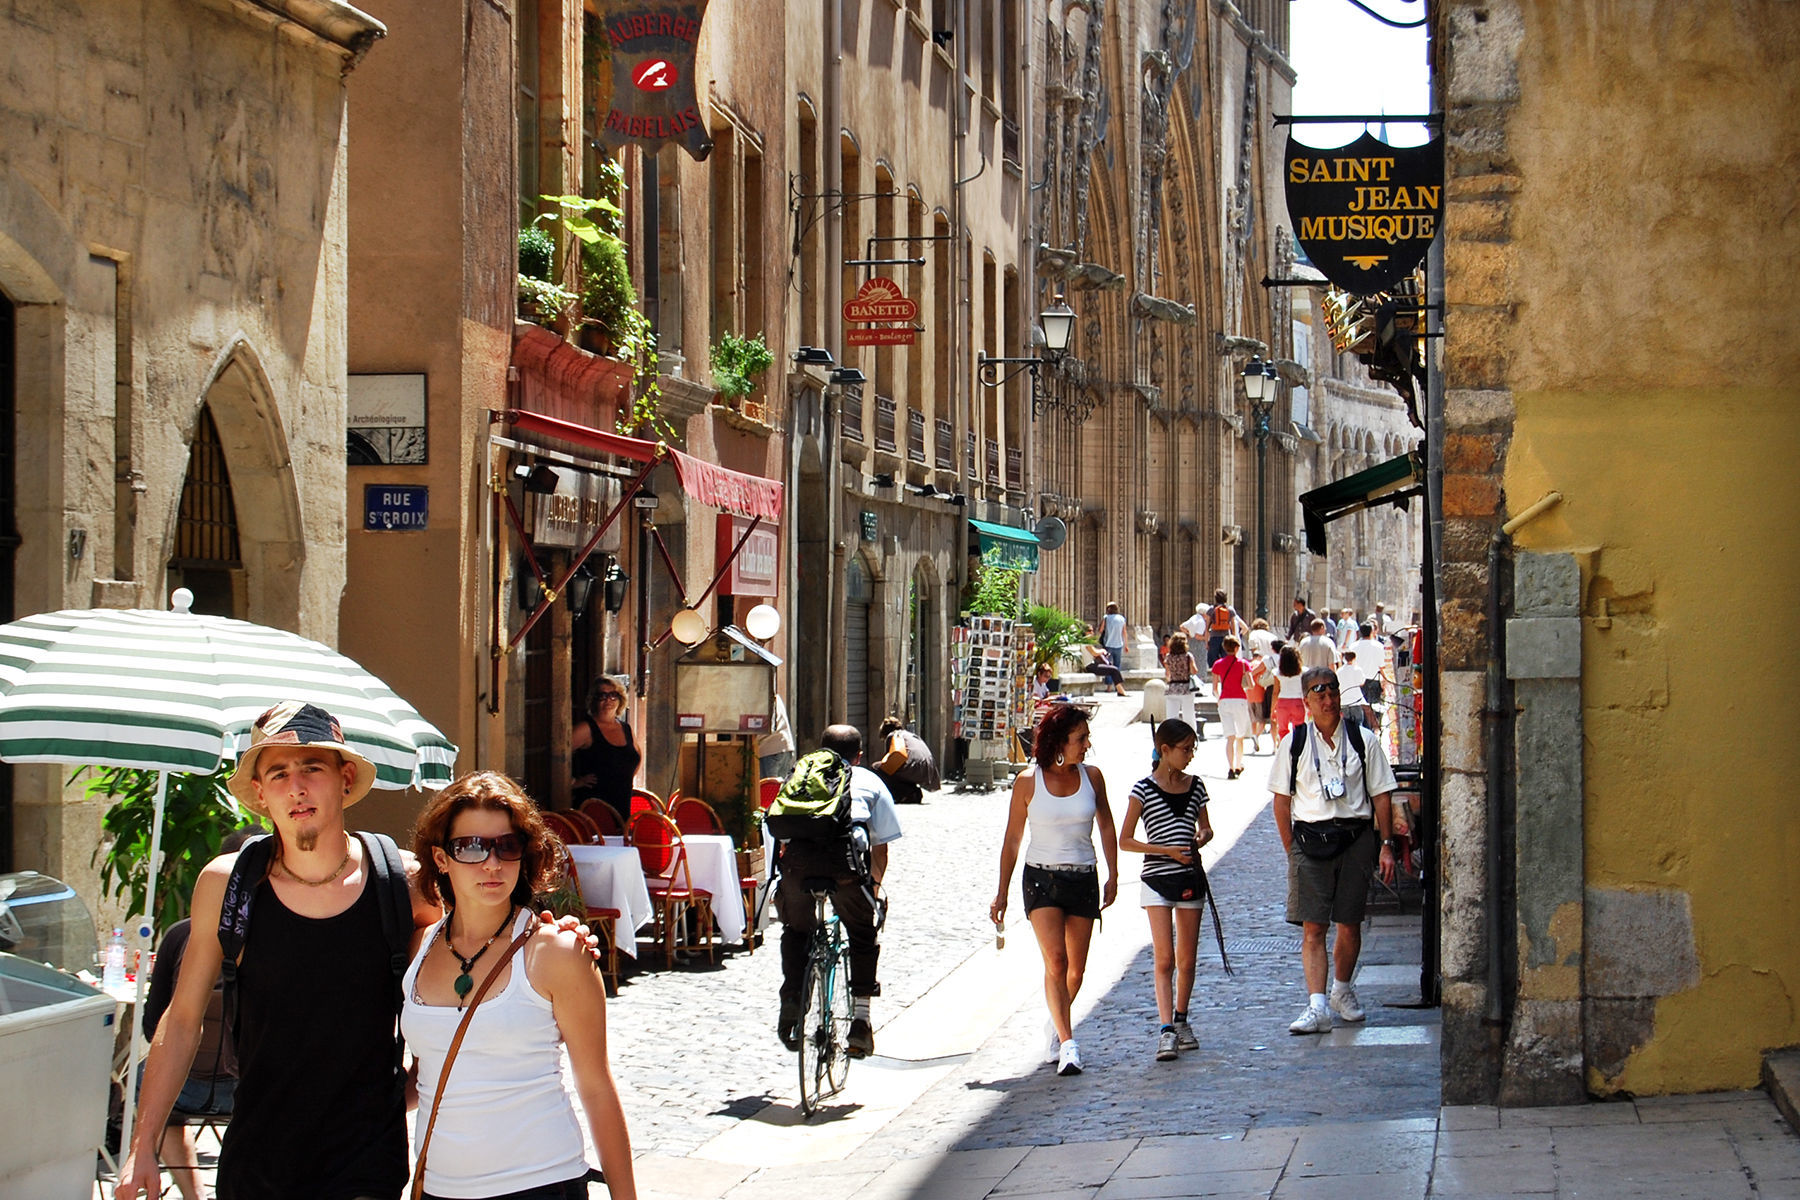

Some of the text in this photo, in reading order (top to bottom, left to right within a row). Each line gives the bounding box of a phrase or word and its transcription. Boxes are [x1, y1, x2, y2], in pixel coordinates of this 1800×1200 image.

[608, 13, 699, 47] AUBERGE
[606, 106, 700, 139] RABELAIS
[1289, 156, 1395, 184] SAINT
[1348, 185, 1442, 212] JEAN
[1299, 214, 1436, 246] MUSIQUE
[850, 304, 910, 317] BANETTE
[352, 413, 407, 425] Archéologique
[382, 492, 412, 507] RUE
[383, 510, 426, 526] CROIX
